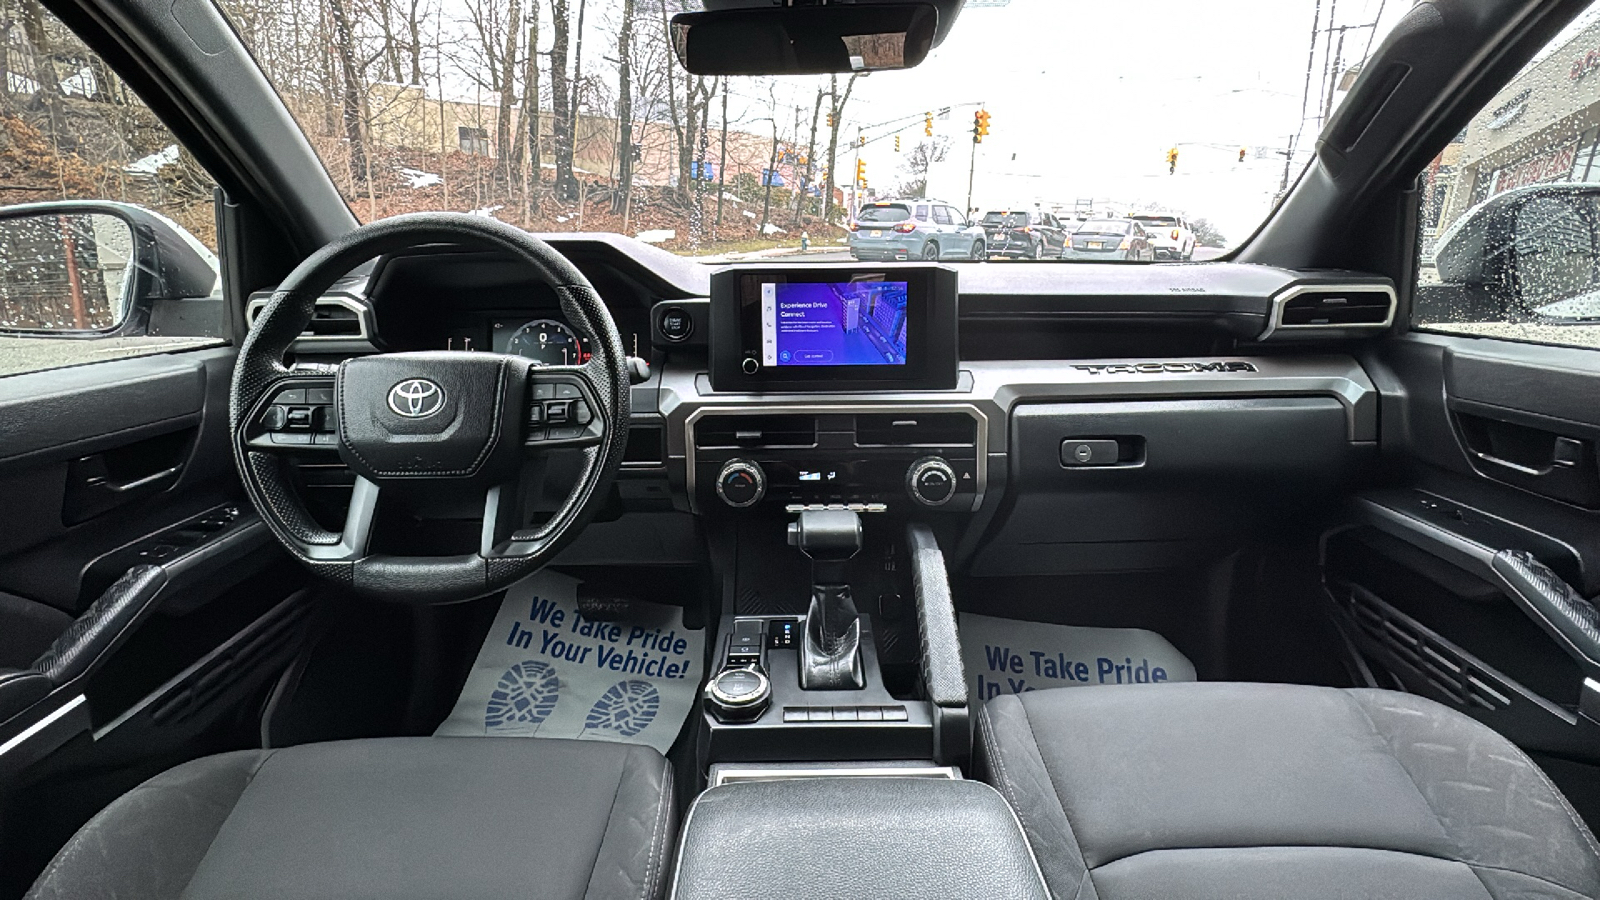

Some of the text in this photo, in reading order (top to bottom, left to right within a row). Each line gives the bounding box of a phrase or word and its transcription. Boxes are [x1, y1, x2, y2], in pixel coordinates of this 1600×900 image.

[1069, 361, 1259, 375] TACOMA
[506, 621, 691, 679] In Your Vehicle!
[529, 596, 687, 655] We Take Pride
[984, 644, 1168, 684] We Take Pride
